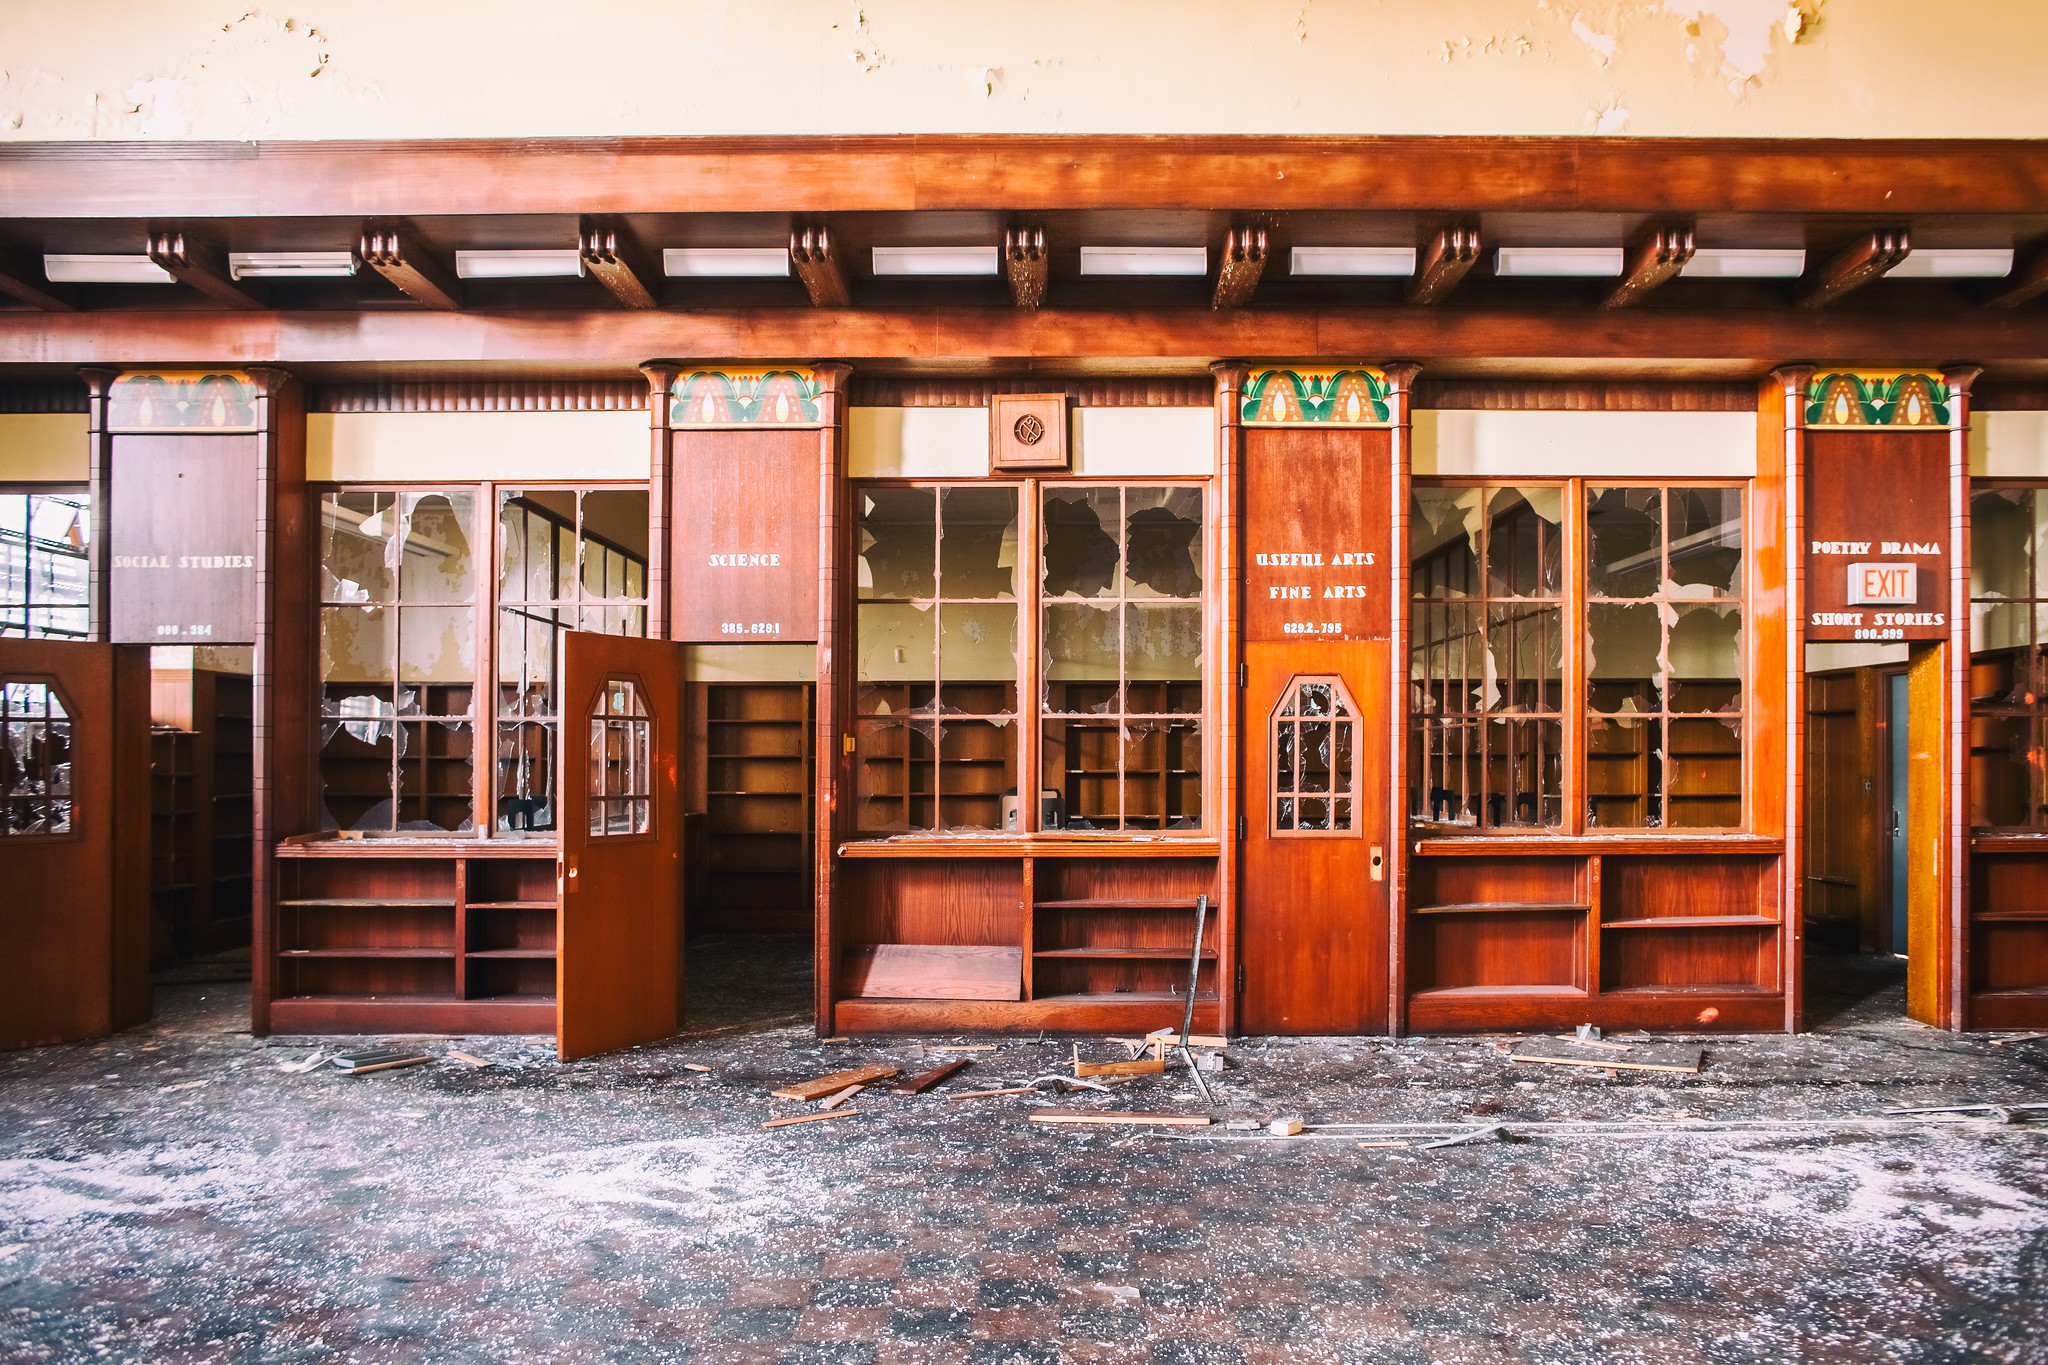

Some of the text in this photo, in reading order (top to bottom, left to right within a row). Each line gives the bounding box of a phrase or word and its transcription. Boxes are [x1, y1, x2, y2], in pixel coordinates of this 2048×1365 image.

[1811, 541, 1942, 554] POETRY DRAMA
[114, 556, 254, 568] SOCIAL STUDIES
[707, 553, 780, 566] SCIENCE
[1255, 553, 1376, 567] USEFUL ARTS
[1864, 569, 1909, 598] EXIT
[1270, 586, 1367, 599] FINE ARTS
[1811, 612, 1945, 626] SHORT STORIES
